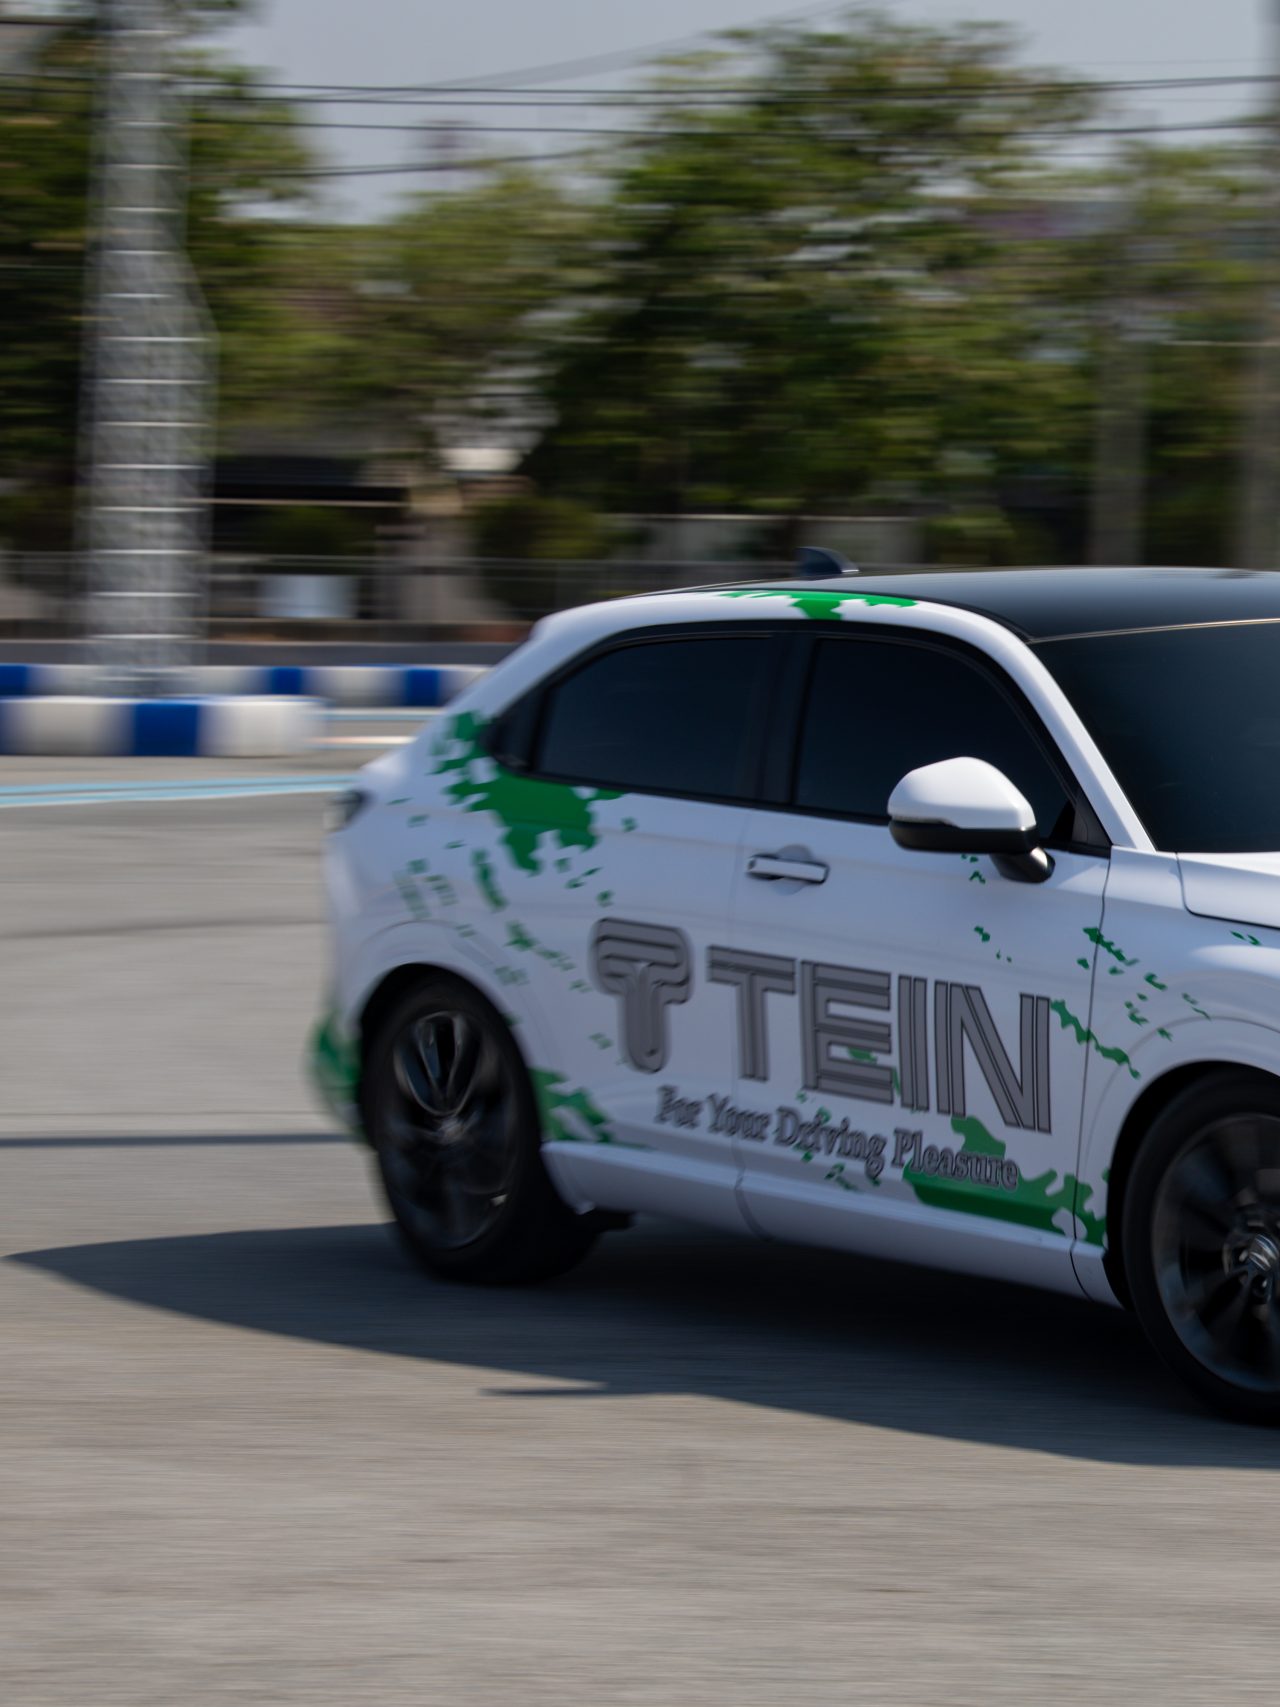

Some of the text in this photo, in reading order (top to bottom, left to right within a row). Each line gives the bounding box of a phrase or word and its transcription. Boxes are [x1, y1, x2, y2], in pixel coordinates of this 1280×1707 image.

[706, 945, 1052, 1135] TEIN
[654, 1084, 1019, 1191] For Your Driving Pleasure
